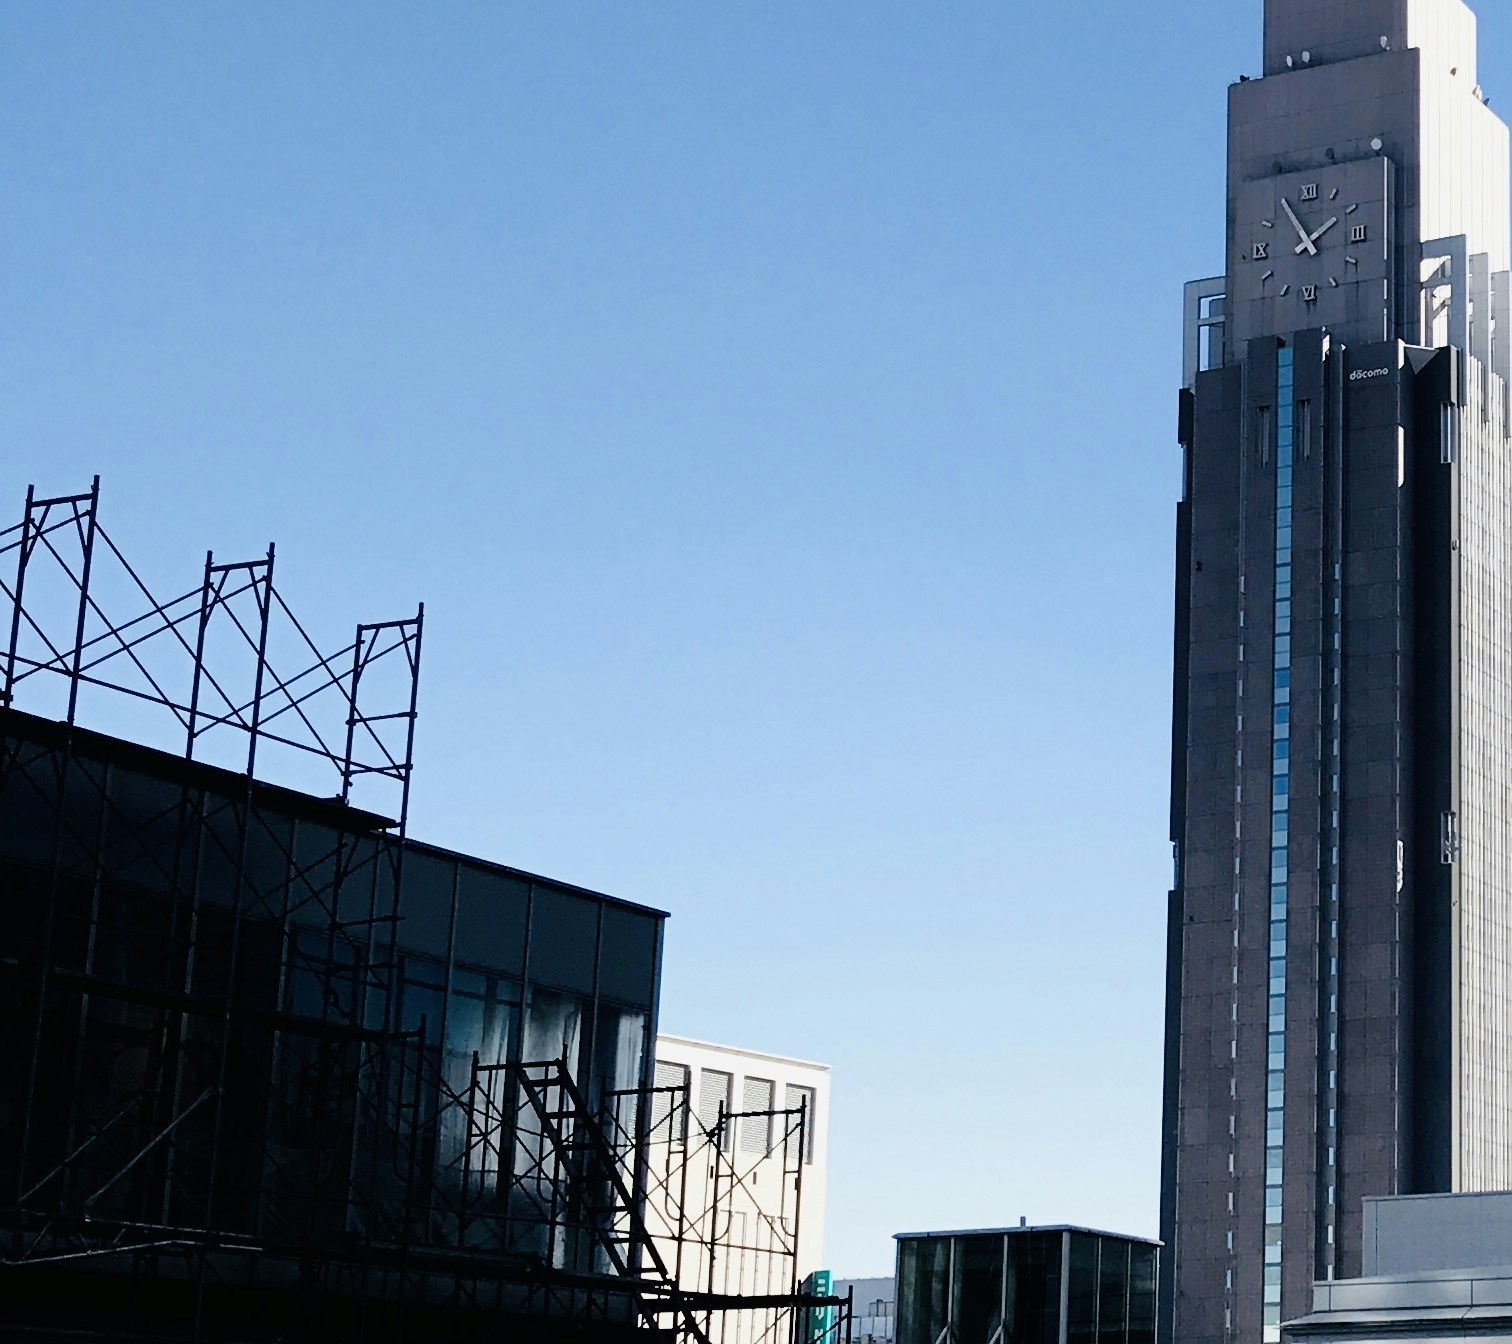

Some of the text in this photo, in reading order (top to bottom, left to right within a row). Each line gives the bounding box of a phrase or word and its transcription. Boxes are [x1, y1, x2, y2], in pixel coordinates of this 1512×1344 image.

[1301, 183, 1318, 200] XII
[1351, 224, 1366, 241] III
[1253, 243, 1267, 259] IX
[1302, 284, 1317, 301] VI
